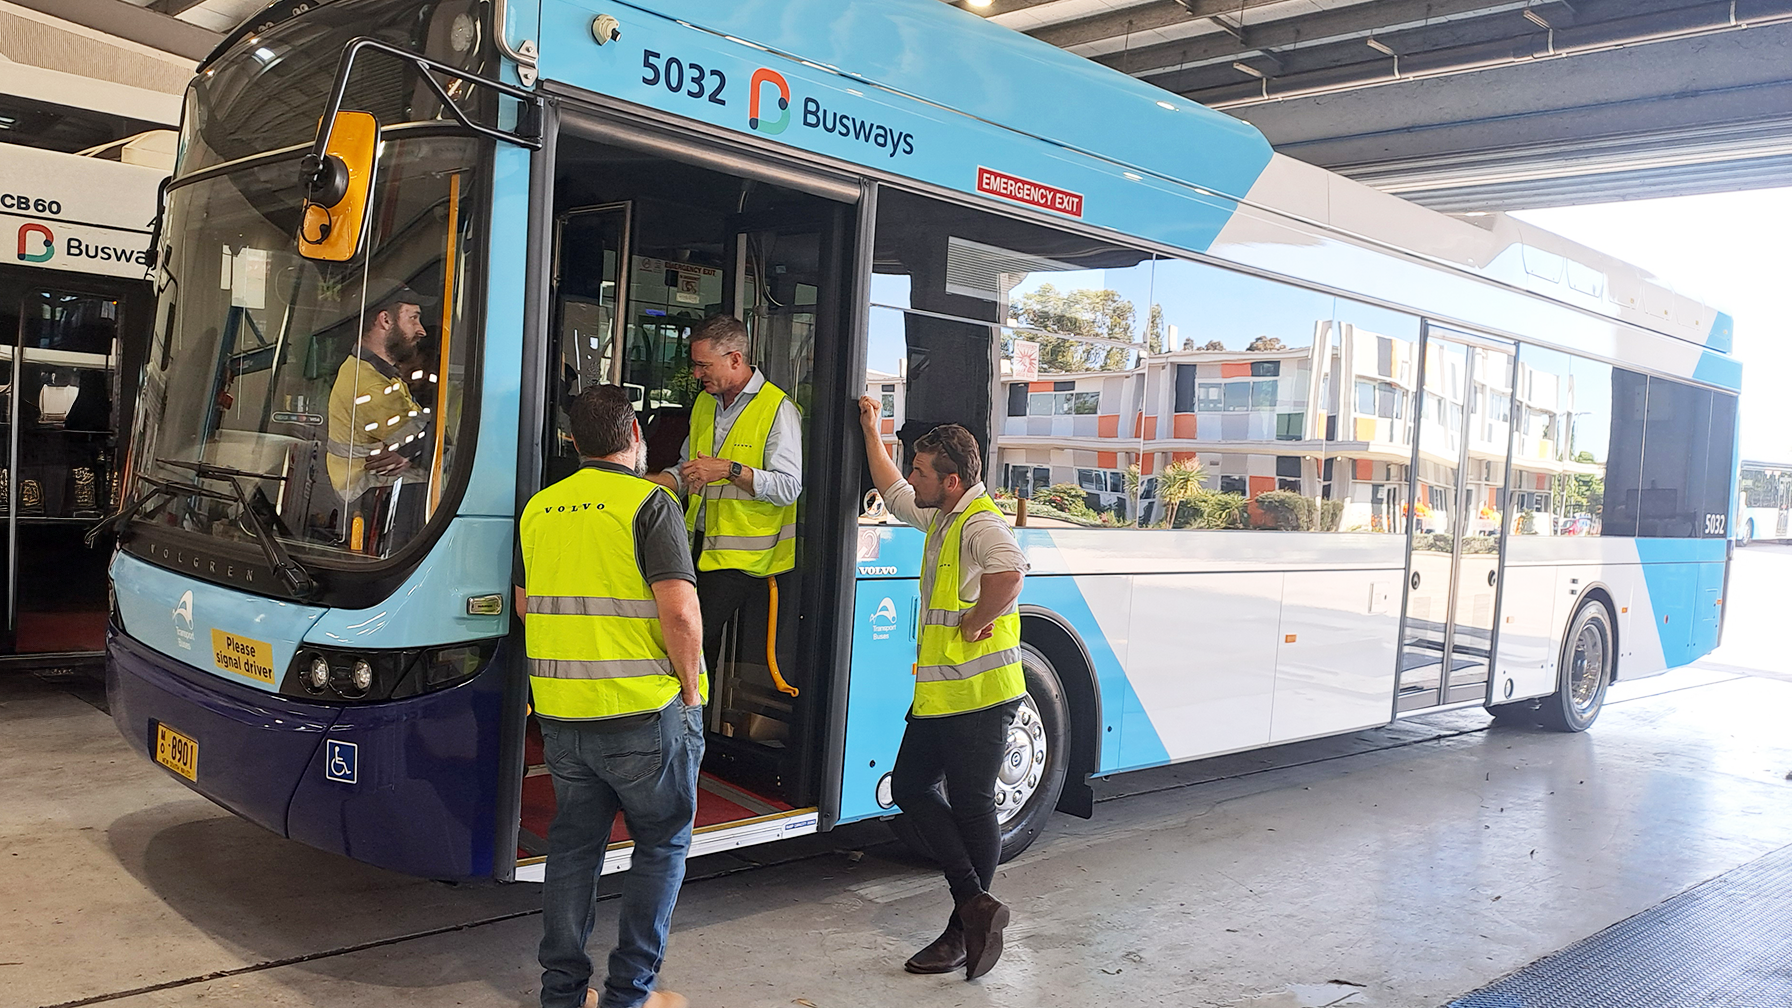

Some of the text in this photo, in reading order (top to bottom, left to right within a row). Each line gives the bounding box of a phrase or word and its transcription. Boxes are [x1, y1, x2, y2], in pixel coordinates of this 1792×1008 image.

[642, 49, 727, 106] 5032
[802, 97, 915, 158] Busways
[982, 172, 1079, 212] EMERGENCY EXIT
[66, 237, 152, 267] Buswa
[664, 261, 702, 274] EMERGENCY
[544, 502, 605, 513] VOLVO
[1704, 513, 1726, 535] 5032
[150, 543, 254, 582] VOLGREN
[858, 566, 897, 575] VOLVO
[872, 624, 896, 633] Transport
[872, 633, 889, 641] Buses
[226, 635, 256, 658] Please
[216, 650, 273, 680] signal driver
